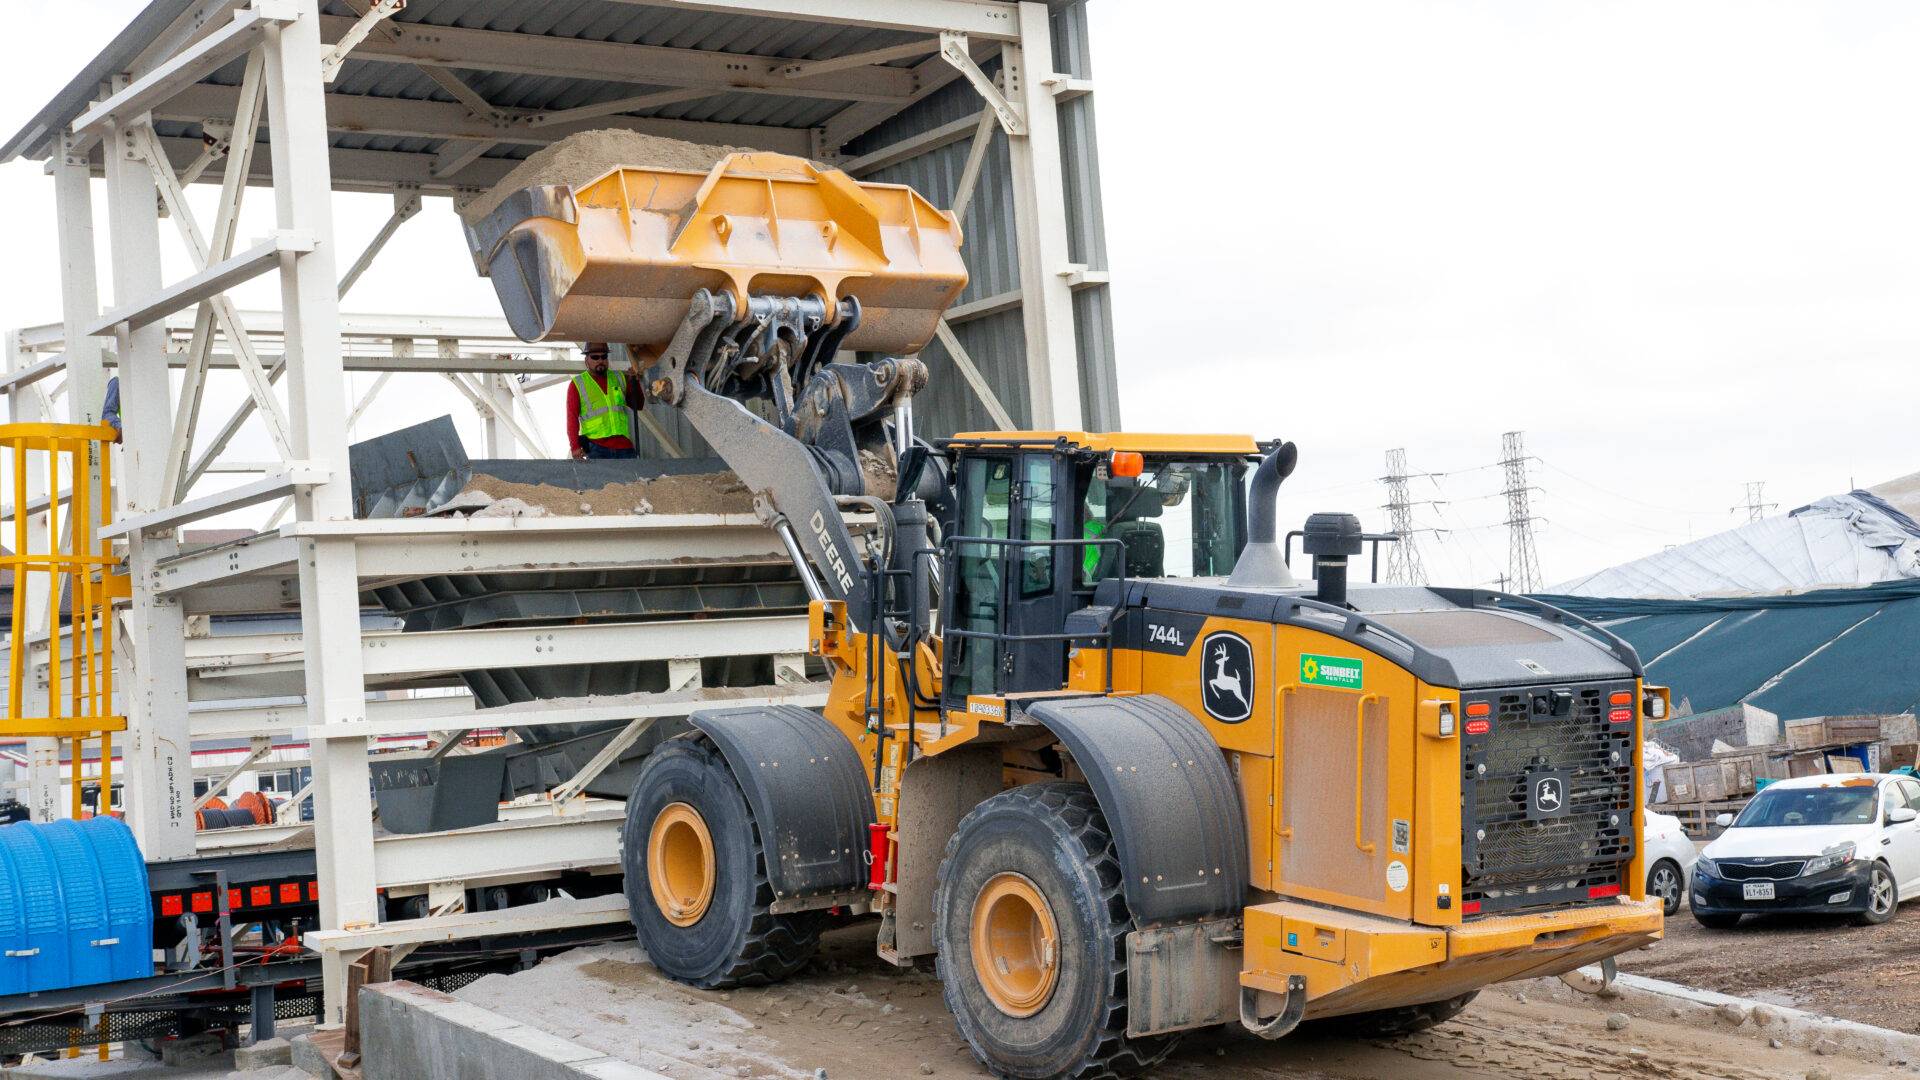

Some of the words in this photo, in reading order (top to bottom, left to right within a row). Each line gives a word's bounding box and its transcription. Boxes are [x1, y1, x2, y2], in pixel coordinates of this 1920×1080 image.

[810, 509, 854, 596] DEERE
[1148, 623, 1185, 647] 744L
[1320, 664, 1360, 679] SUNBELT
